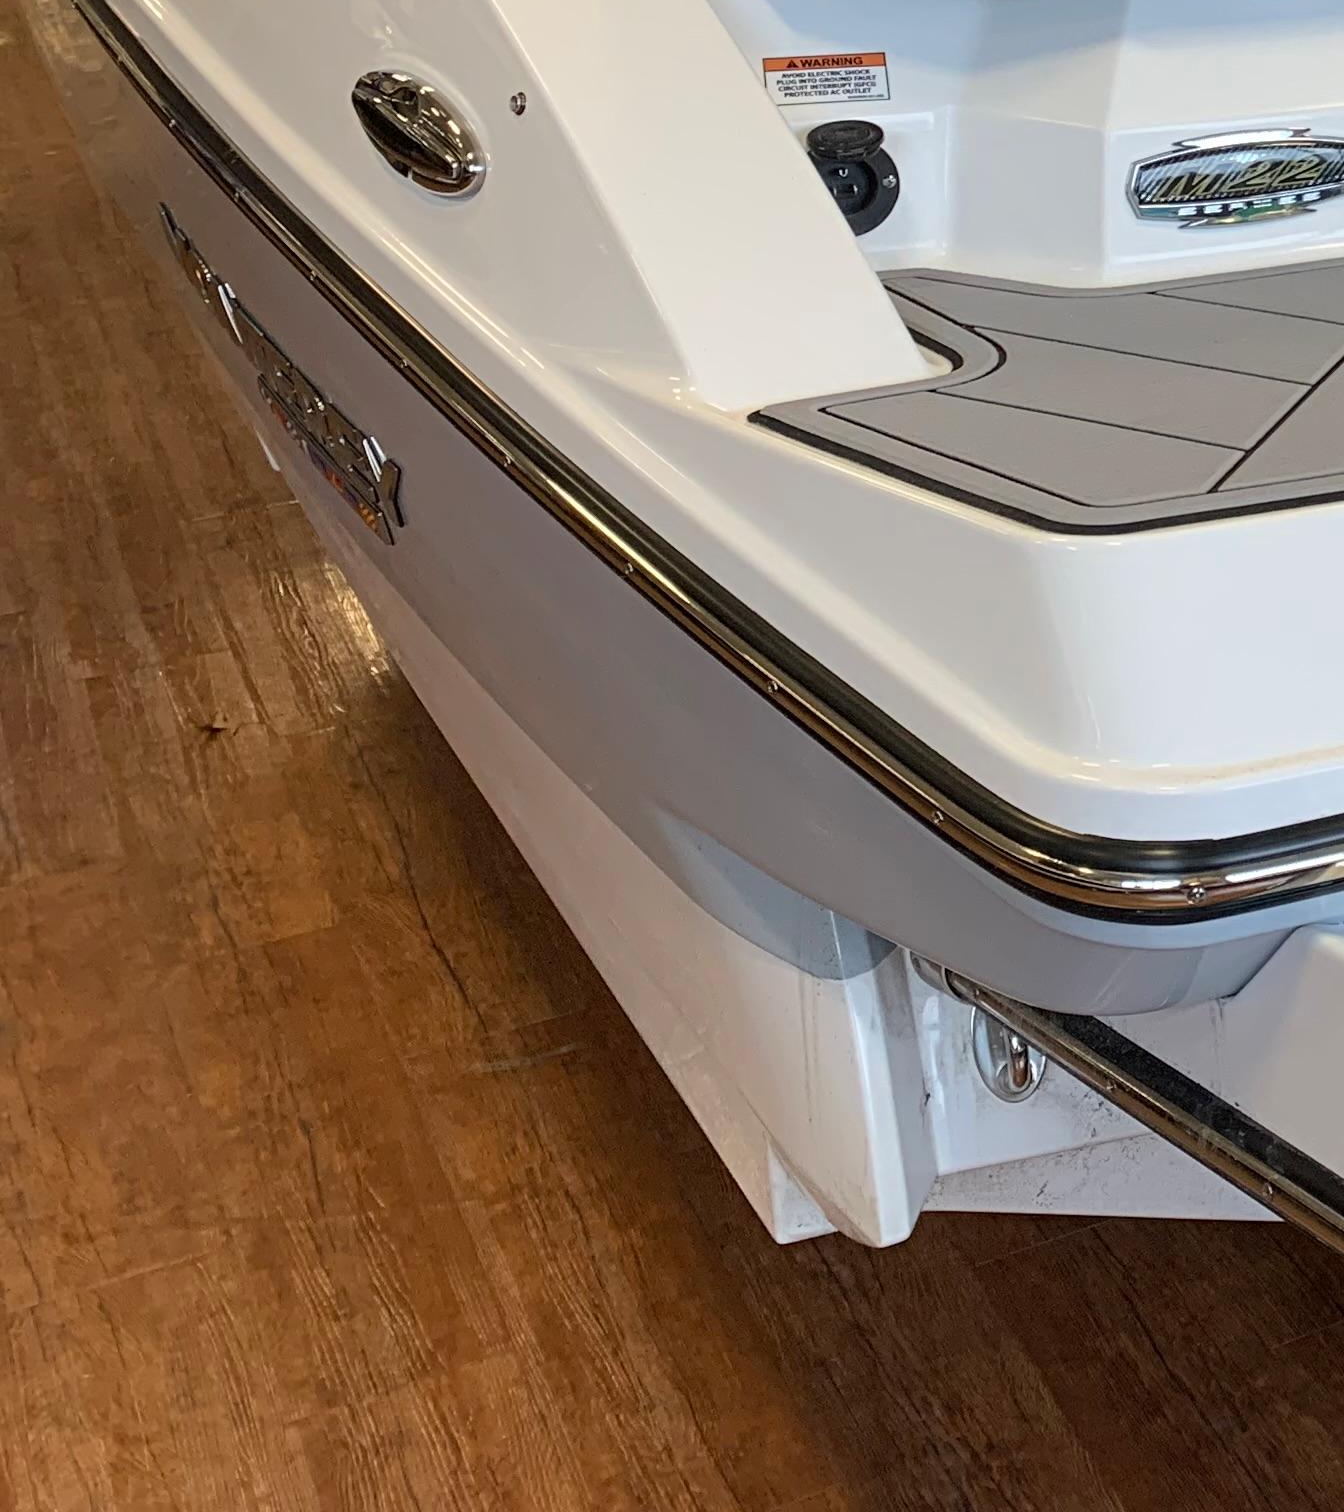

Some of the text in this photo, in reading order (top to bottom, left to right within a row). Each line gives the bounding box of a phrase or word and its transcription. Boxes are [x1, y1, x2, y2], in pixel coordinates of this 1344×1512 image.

[800, 56, 863, 68] WARNING
[807, 70, 842, 78] ELECTRIC
[799, 77, 817, 85] INTO
[810, 83, 853, 91] INTERRUPT
[784, 90, 829, 98] PROTECTED
[842, 87, 872, 95] OUTLET
[1177, 191, 1323, 216] SERIES
